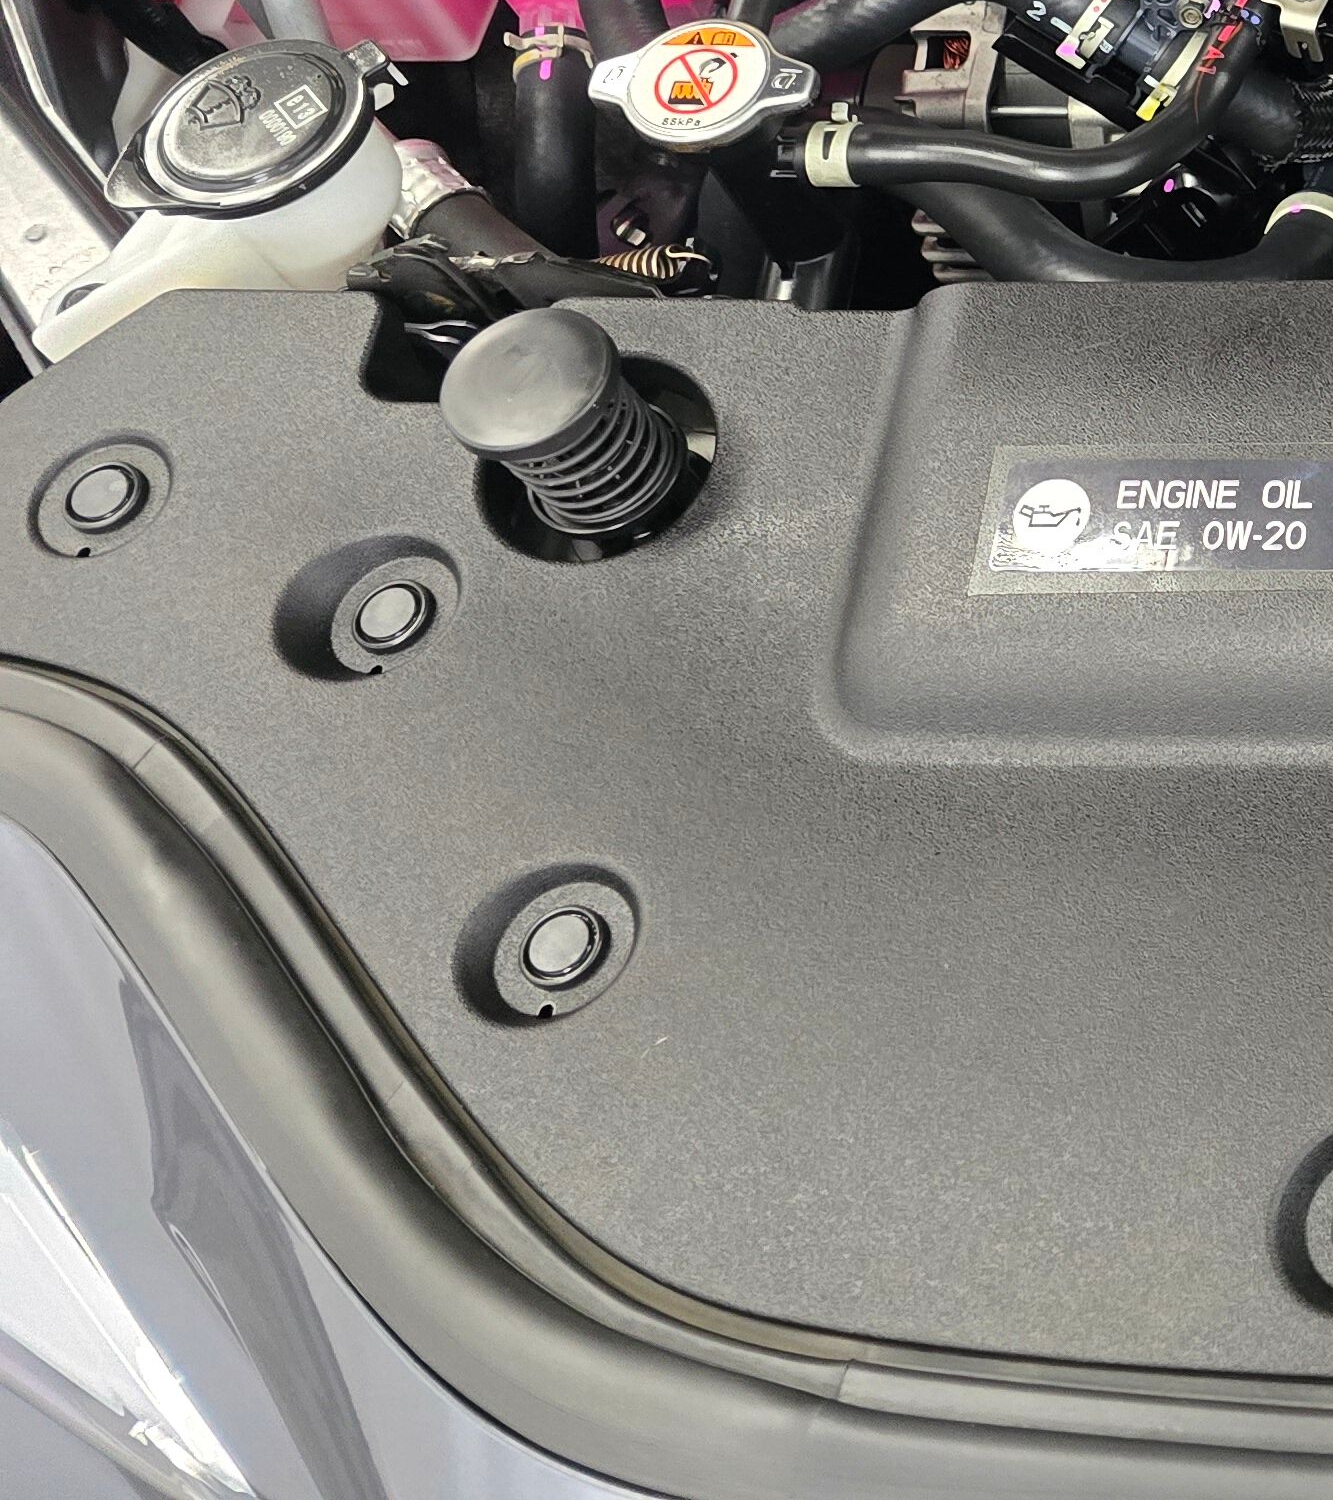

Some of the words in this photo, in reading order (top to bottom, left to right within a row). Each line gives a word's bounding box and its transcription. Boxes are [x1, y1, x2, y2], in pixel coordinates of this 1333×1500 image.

[284, 92, 317, 121] e13
[1115, 478, 1240, 510] ENGINE
[1260, 479, 1314, 510] OIL
[1112, 520, 1181, 551] SAE
[1201, 520, 1308, 552] 0W-20
